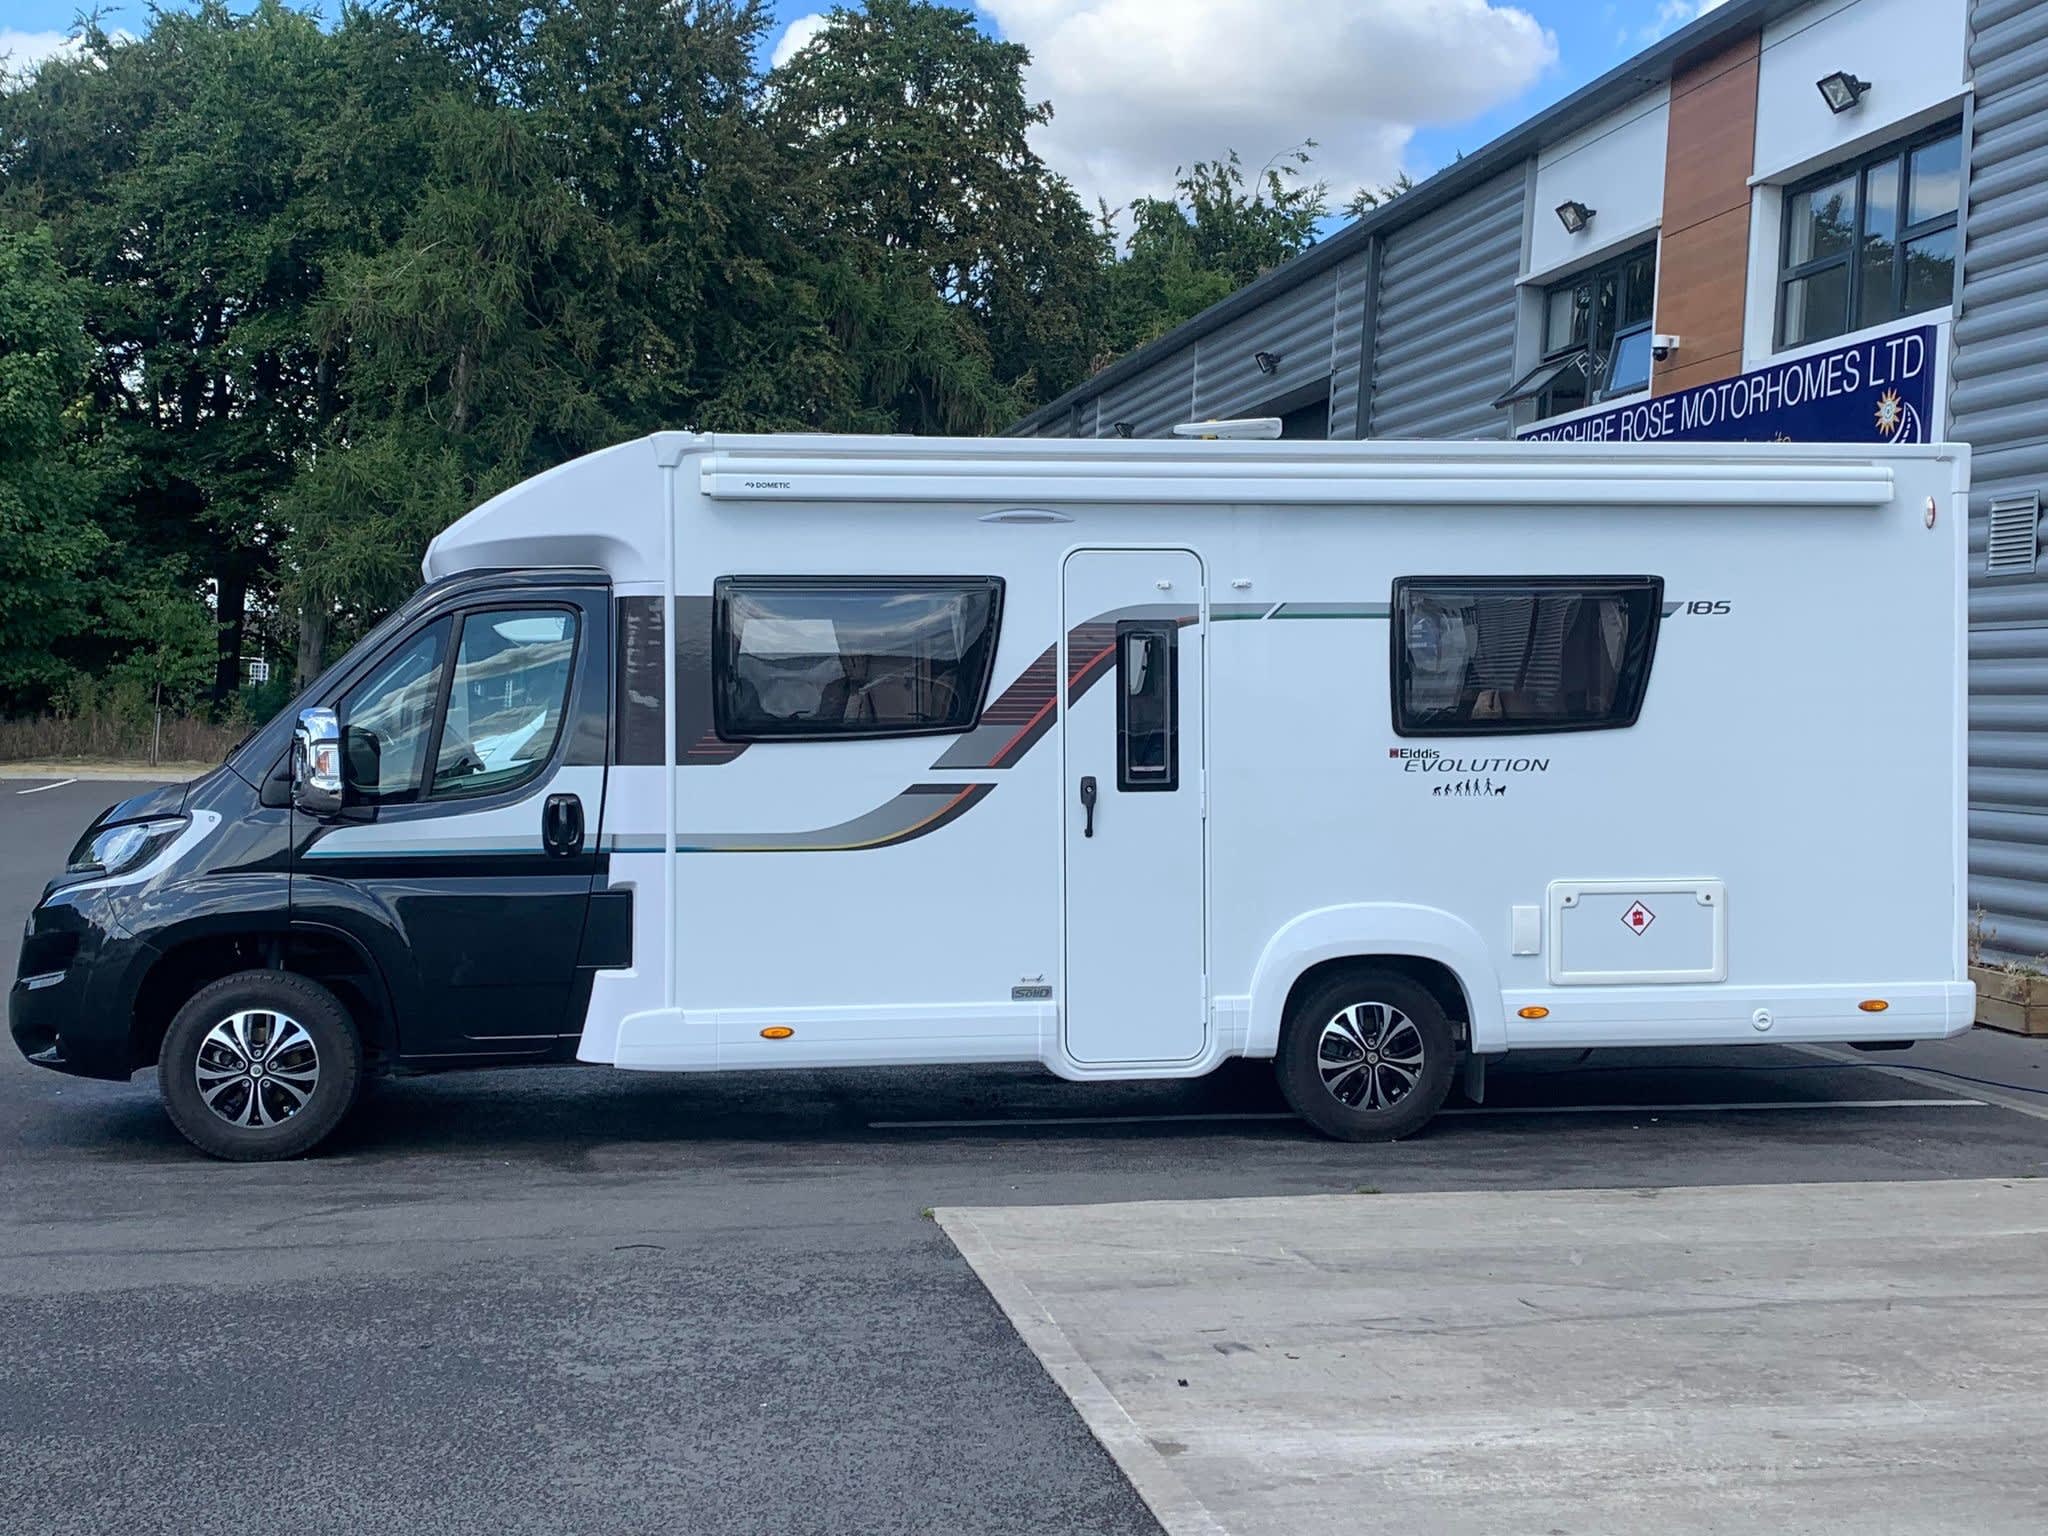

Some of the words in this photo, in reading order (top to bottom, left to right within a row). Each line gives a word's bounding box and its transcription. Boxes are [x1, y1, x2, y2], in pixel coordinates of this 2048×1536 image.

[1621, 399, 1675, 442] ROSE
[1680, 350, 1860, 431] MOTORHOMES
[1869, 334, 1925, 387] LTD
[1686, 600, 1732, 615] 185
[1400, 748, 1441, 759] Elddis
[1403, 758, 1550, 773] EVOLUTION
